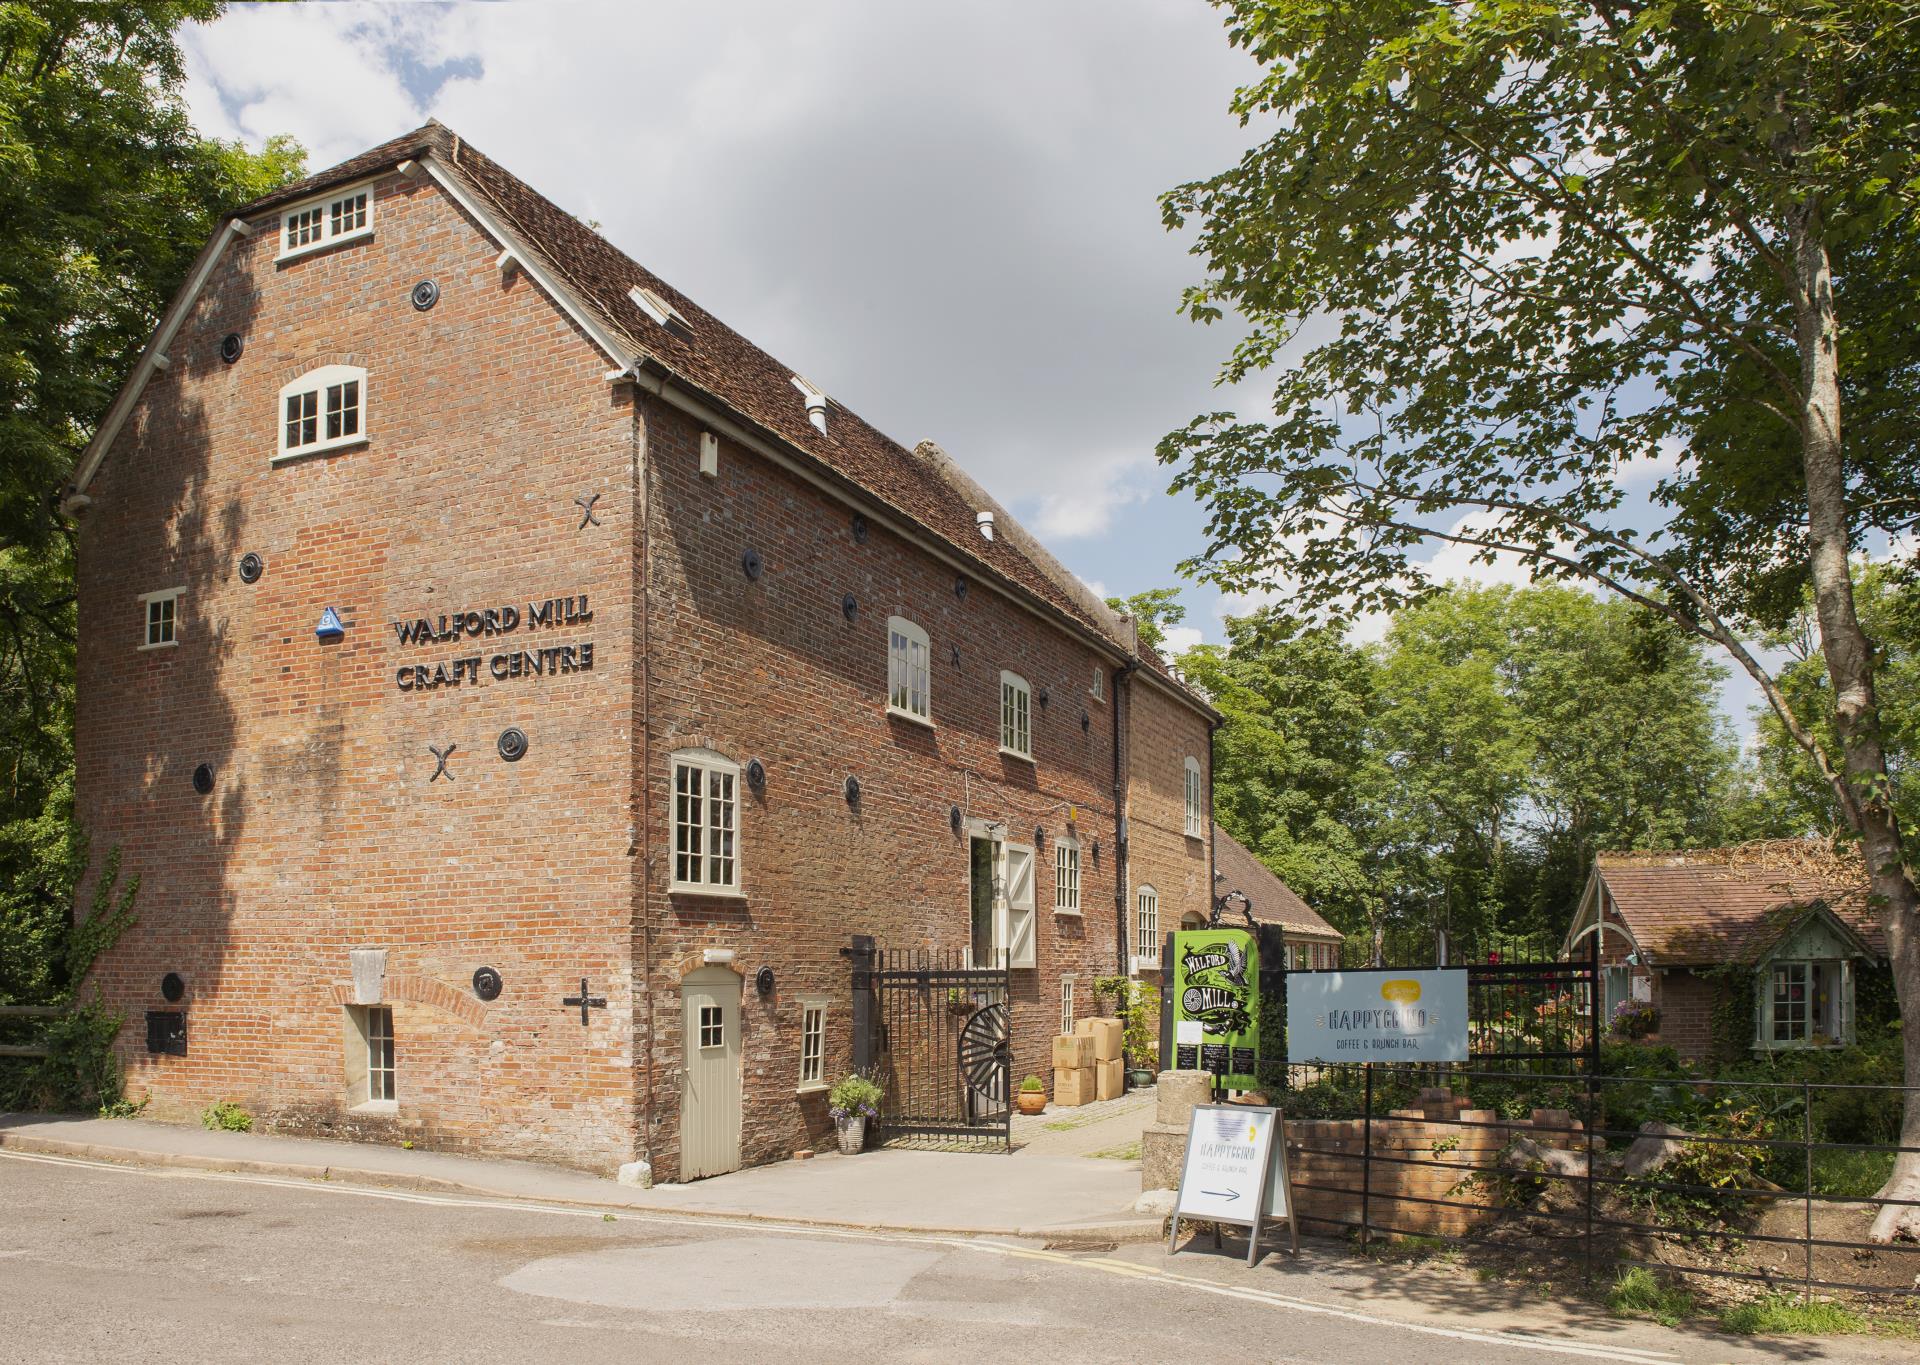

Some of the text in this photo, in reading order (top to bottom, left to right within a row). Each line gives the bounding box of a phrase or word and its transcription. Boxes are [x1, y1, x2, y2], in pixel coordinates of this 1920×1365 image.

[393, 595, 594, 645] WALFORD MILL
[396, 643, 594, 691] CRAFT CENTRE
[1184, 954, 1227, 975] WALFORD
[1202, 987, 1231, 1010] MILL
[1329, 1008, 1426, 1030] HAPPYCCNO
[1336, 1039, 1360, 1050] COFFEE
[1372, 1038, 1399, 1050] BRUNCH
[1402, 1038, 1420, 1050] BAR
